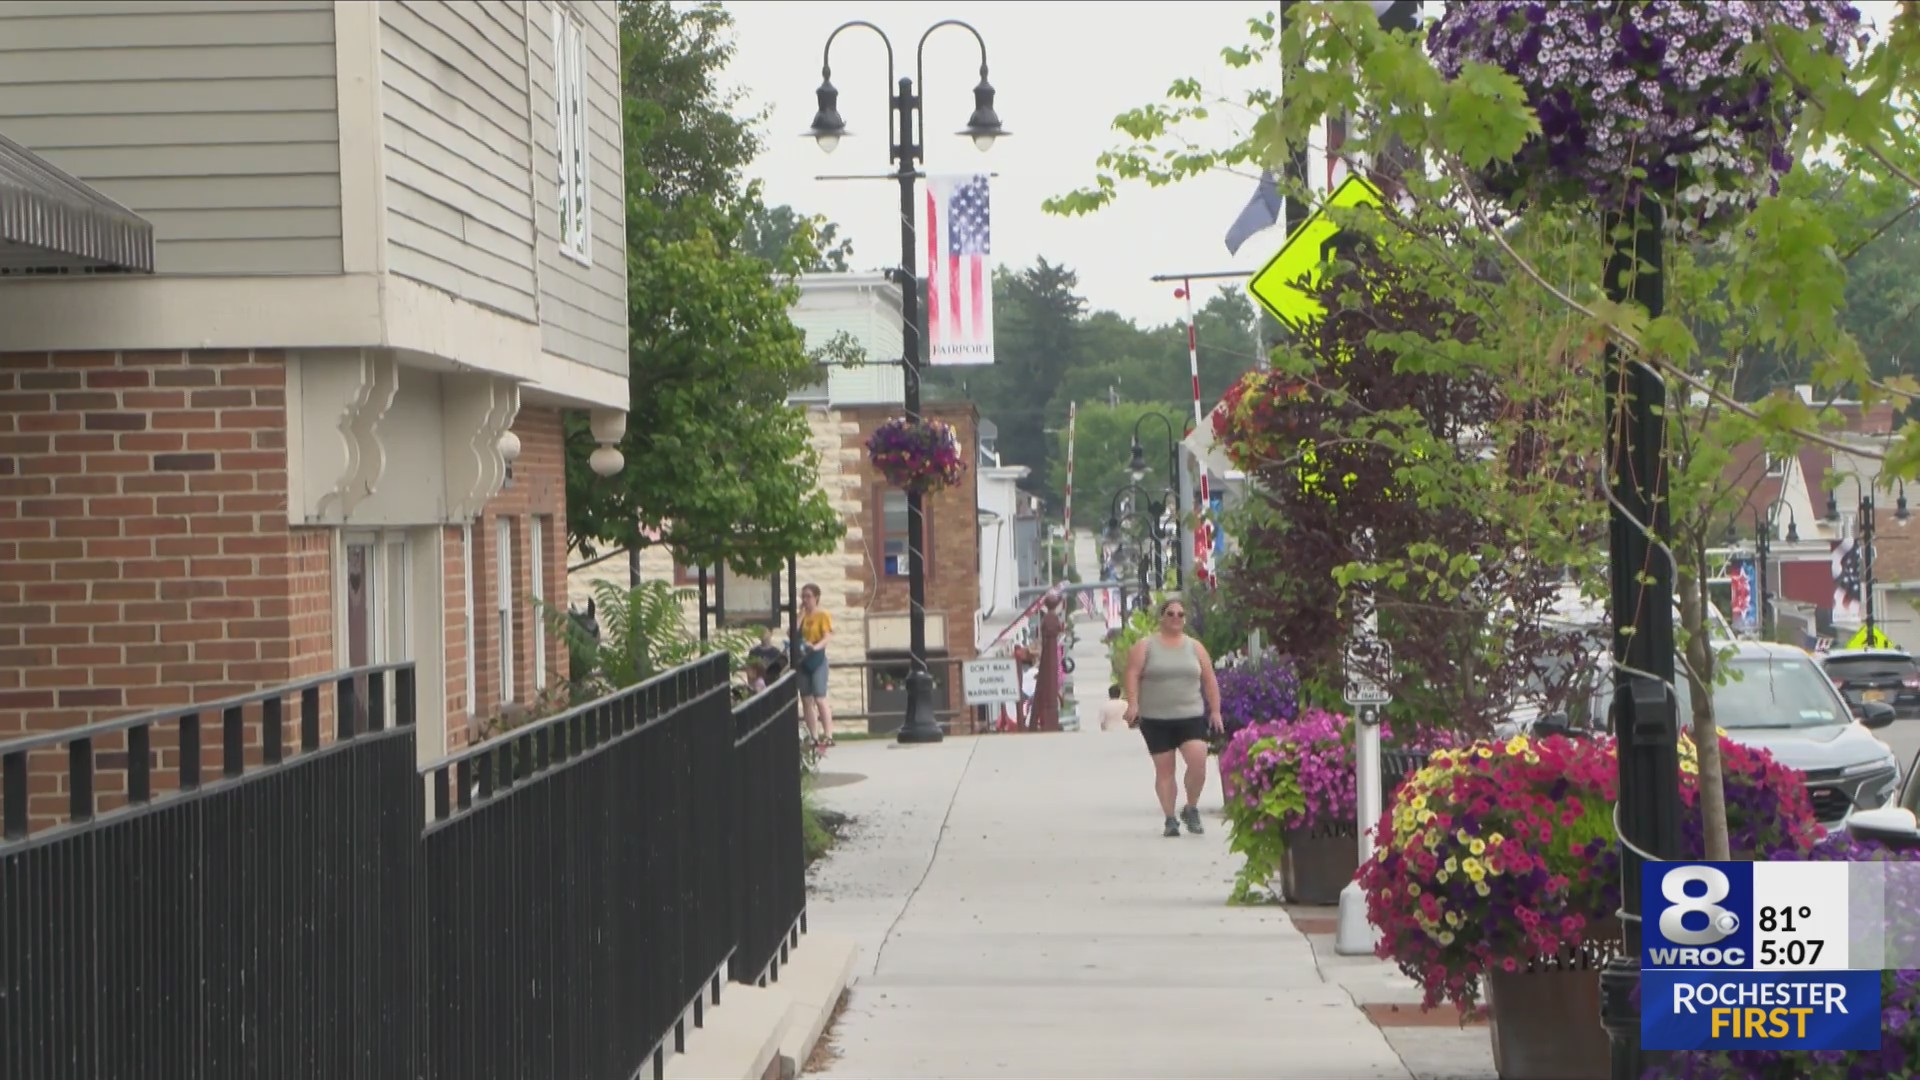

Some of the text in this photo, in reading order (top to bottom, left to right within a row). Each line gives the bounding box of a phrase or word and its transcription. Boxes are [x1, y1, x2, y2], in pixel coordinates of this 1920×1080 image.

[932, 344, 990, 355] FAIRPORT
[970, 664, 990, 672] DON'T
[979, 676, 1004, 684] DURING
[967, 687, 1016, 697] WARNING BELL
